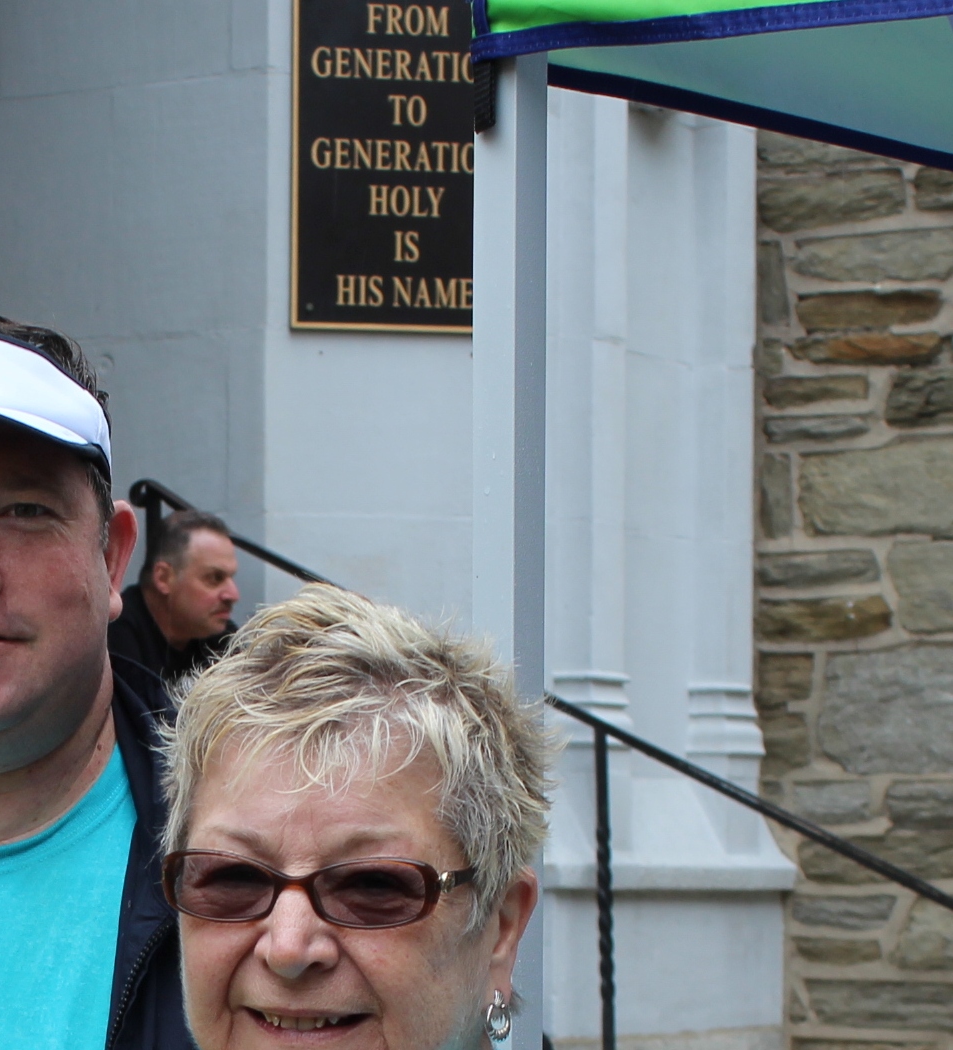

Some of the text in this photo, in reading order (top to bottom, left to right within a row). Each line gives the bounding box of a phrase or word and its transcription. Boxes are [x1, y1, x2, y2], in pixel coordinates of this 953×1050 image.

[366, 3, 450, 37] FROM
[310, 46, 474, 83] GENERATIO
[388, 94, 428, 127] TO
[310, 137, 474, 174] GENERATIO
[368, 184, 445, 218] HOLY
[394, 230, 420, 263] IS
[335, 274, 474, 310] HIS NAME
